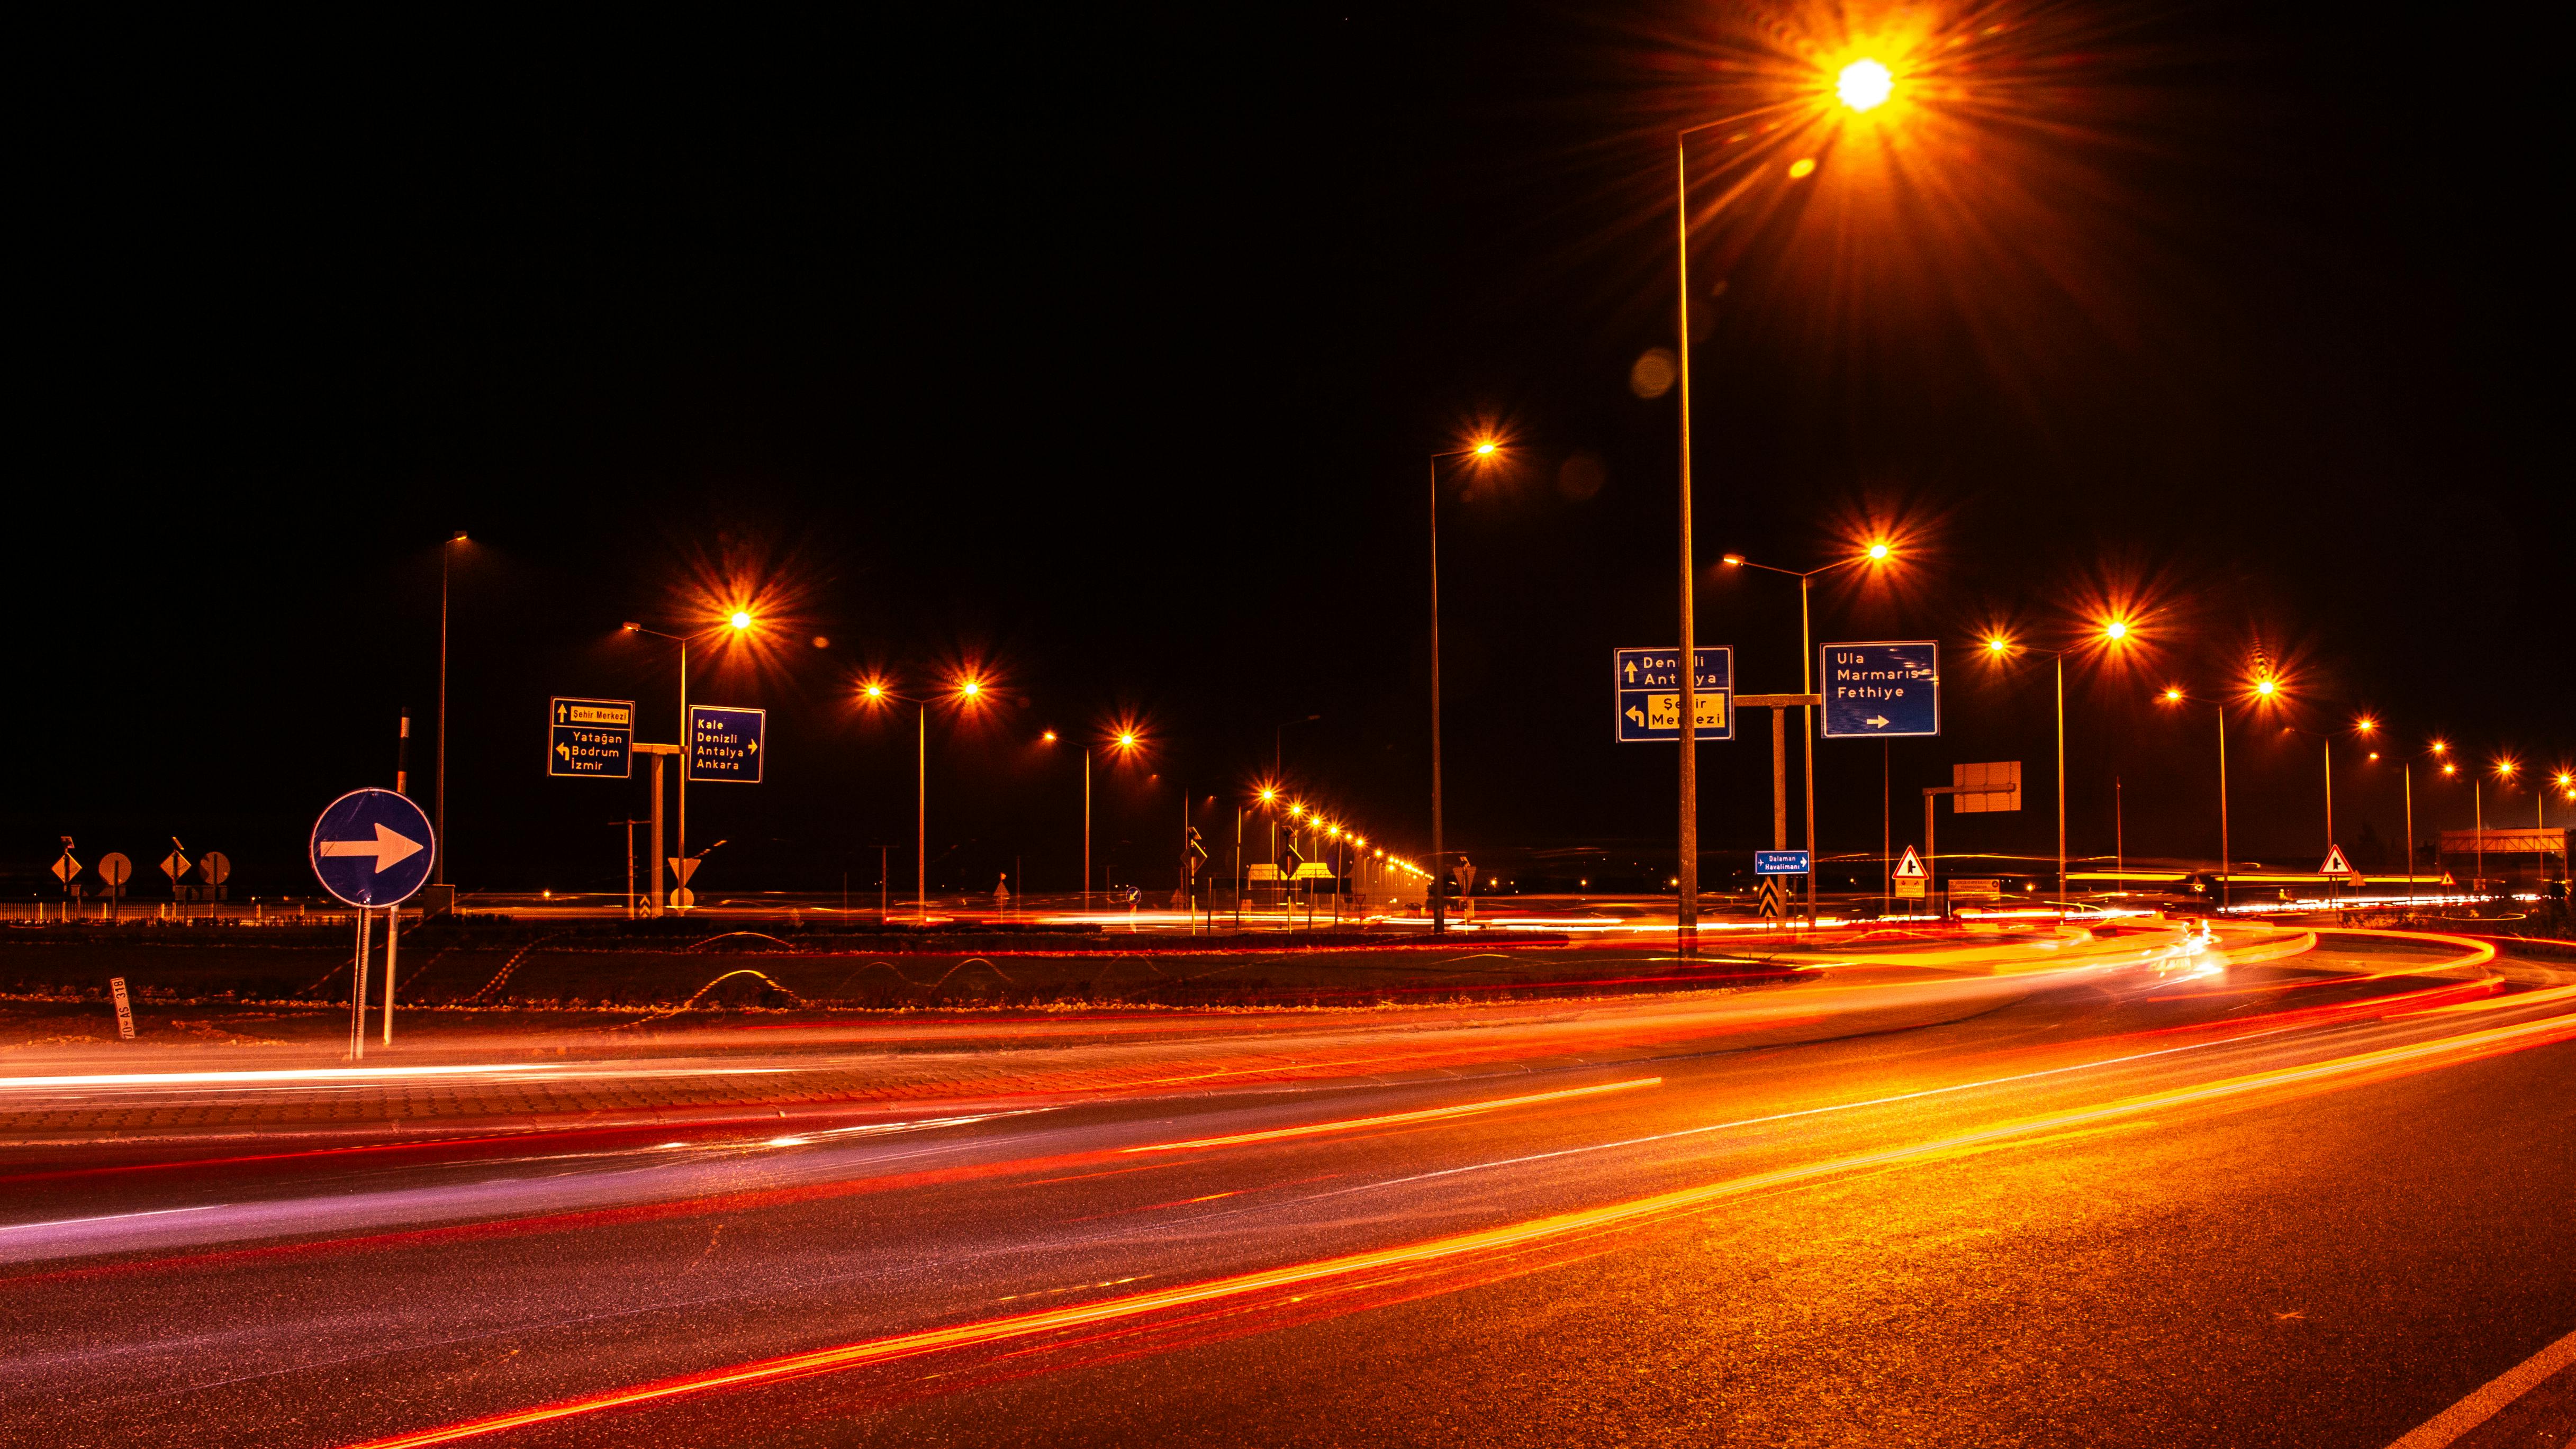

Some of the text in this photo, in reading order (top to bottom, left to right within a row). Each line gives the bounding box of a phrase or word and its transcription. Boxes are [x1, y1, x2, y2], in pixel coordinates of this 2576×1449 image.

[1837, 653, 1864, 664] Ula
[1644, 673, 1716, 686] Antya
[1838, 686, 1904, 701] Fethiye
[1664, 698, 1707, 711] Şeir
[573, 709, 627, 720] Şehir Merkezi
[698, 719, 724, 730] Kale
[573, 731, 622, 745] Yatağan
[697, 732, 737, 744] Denizli
[572, 745, 619, 757] Bodrum
[697, 745, 744, 759] Antalya
[571, 757, 603, 771] İzmir
[697, 758, 739, 770] Ankara
[113, 981, 126, 999] 318
[119, 1007, 130, 1018] AS
